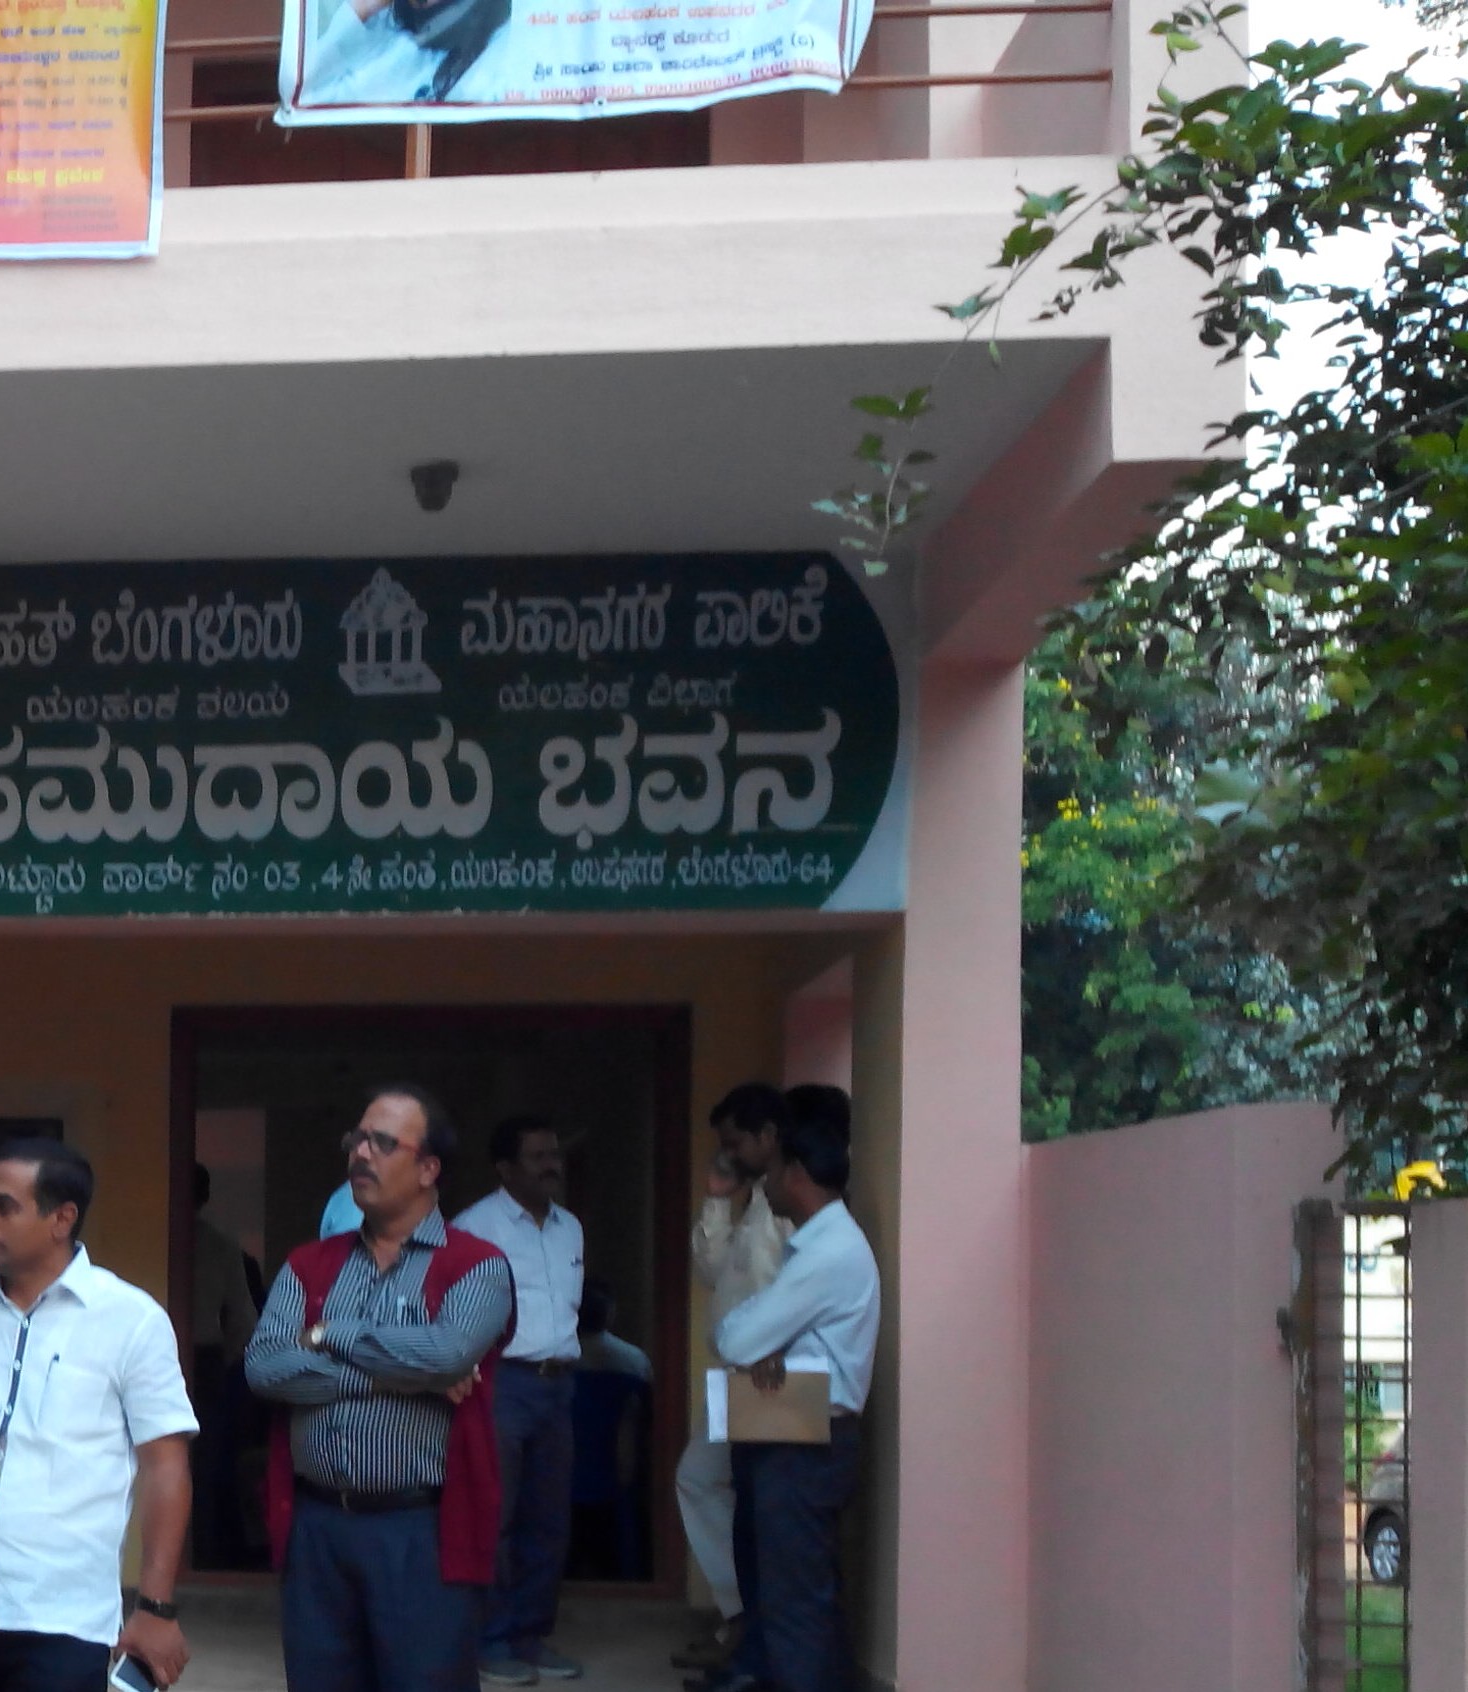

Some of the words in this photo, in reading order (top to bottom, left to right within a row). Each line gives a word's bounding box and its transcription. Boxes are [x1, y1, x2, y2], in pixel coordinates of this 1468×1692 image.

[90, 588, 302, 667] ಬೆಂಗಳೂರು
[461, 583, 672, 661] ಮಹಾನಗರ
[694, 564, 829, 648] ಪಾಲಿಕೆ
[26, 685, 180, 723] ಯಲಹಂಕ
[197, 682, 290, 718] ವಲಯ
[499, 673, 634, 712] ಯಲಹಂಕ
[647, 671, 738, 714] ವಿಭಾಗ
[538, 707, 841, 850] ಭವನ
